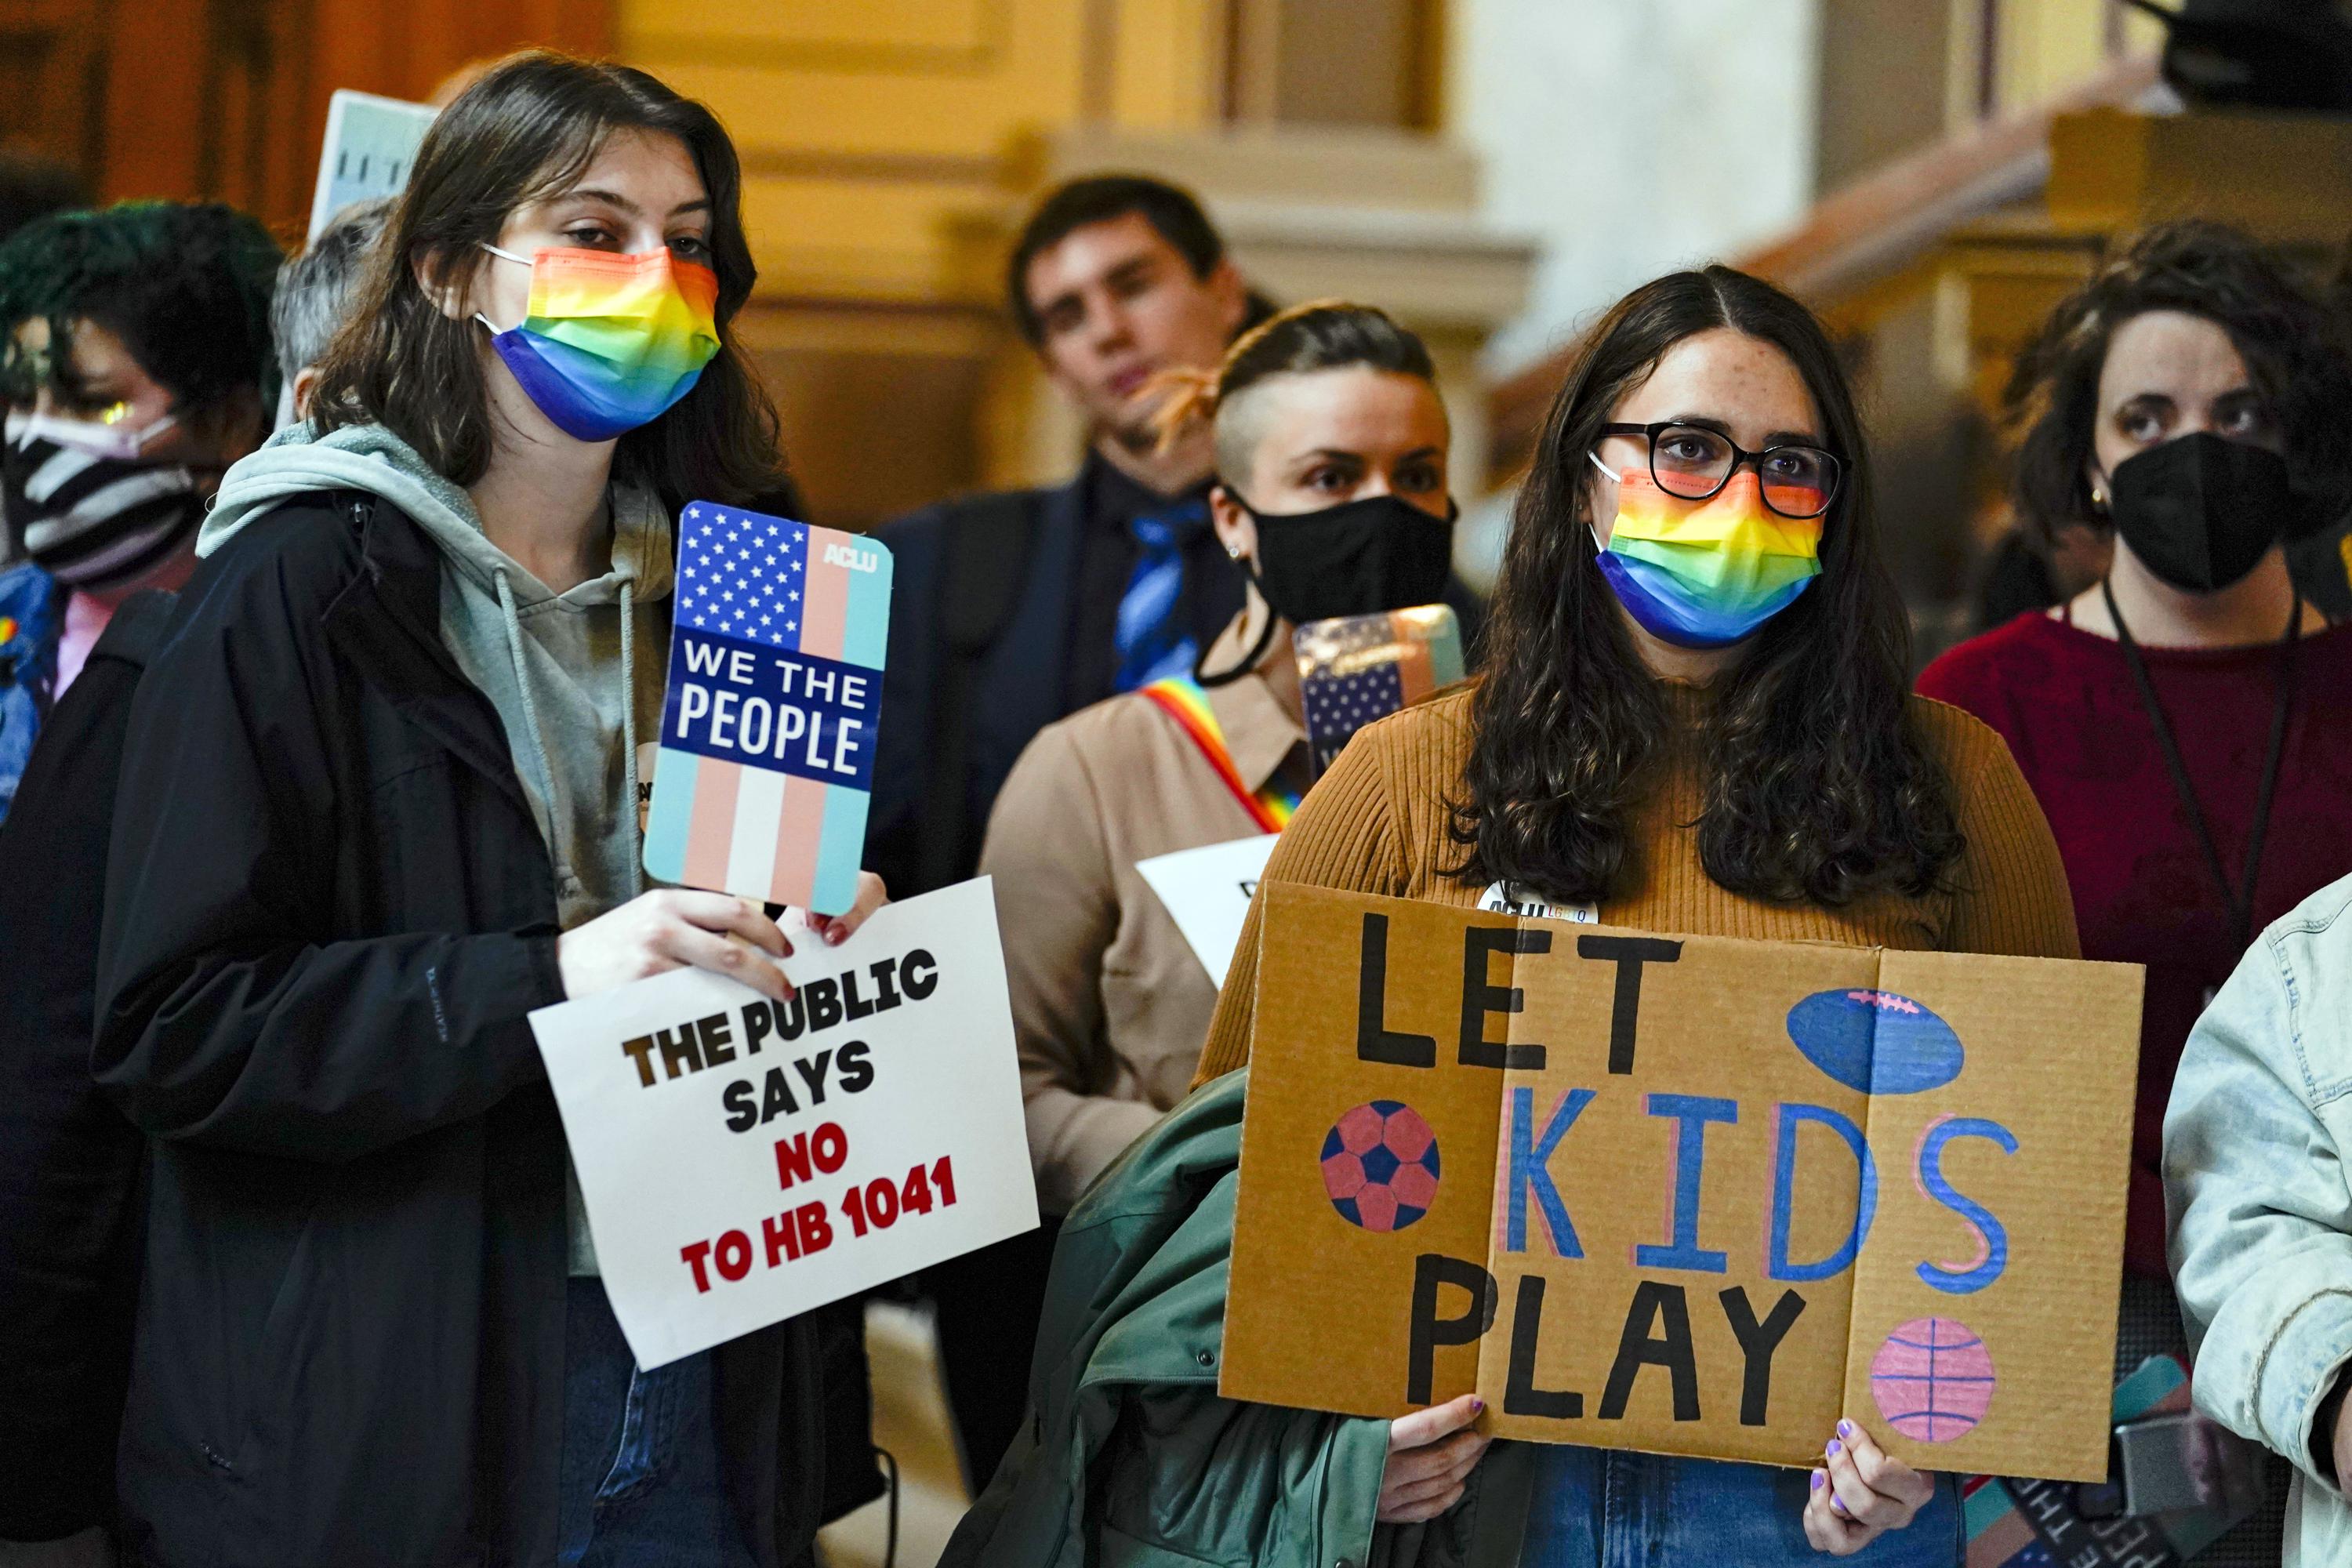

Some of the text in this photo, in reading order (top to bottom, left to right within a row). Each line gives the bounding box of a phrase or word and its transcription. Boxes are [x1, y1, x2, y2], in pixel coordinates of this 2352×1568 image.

[824, 543, 877, 573] ACLU
[677, 683, 862, 775] PEOPLE
[684, 639, 867, 710] WE THE
[622, 949, 938, 1088] THE PUBLIC
[1357, 912, 1685, 1076] LET
[722, 1040, 875, 1134] SAYS
[775, 1122, 848, 1191] NO
[1498, 1087, 2020, 1295] KIDS
[681, 1156, 956, 1294] TO HB 1041
[1407, 1254, 1806, 1426] PLAY
